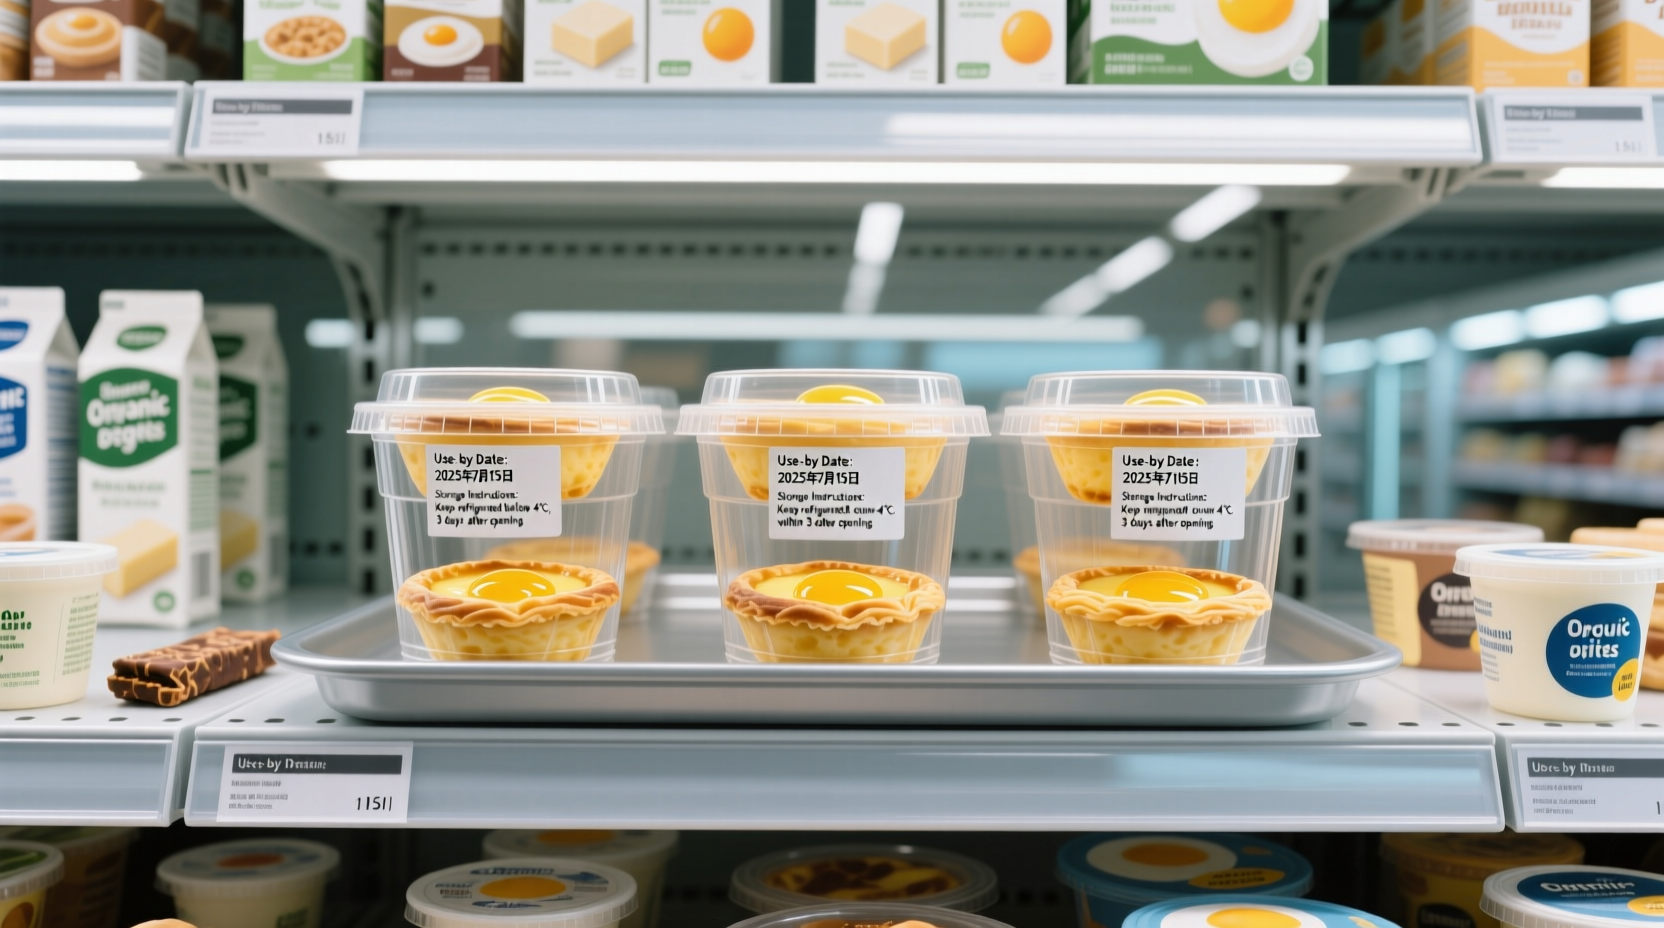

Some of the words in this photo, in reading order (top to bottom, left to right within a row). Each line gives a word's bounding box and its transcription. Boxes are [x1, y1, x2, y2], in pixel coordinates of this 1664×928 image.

[476, 453, 508, 465] Date:
[777, 454, 819, 469] Use-by
[821, 455, 853, 467] Date:
[1122, 454, 1165, 470] Use-by
[435, 469, 513, 483] 2025年7月15日
[777, 471, 859, 485] 2025年7月15日
[806, 516, 812, 527] 3
